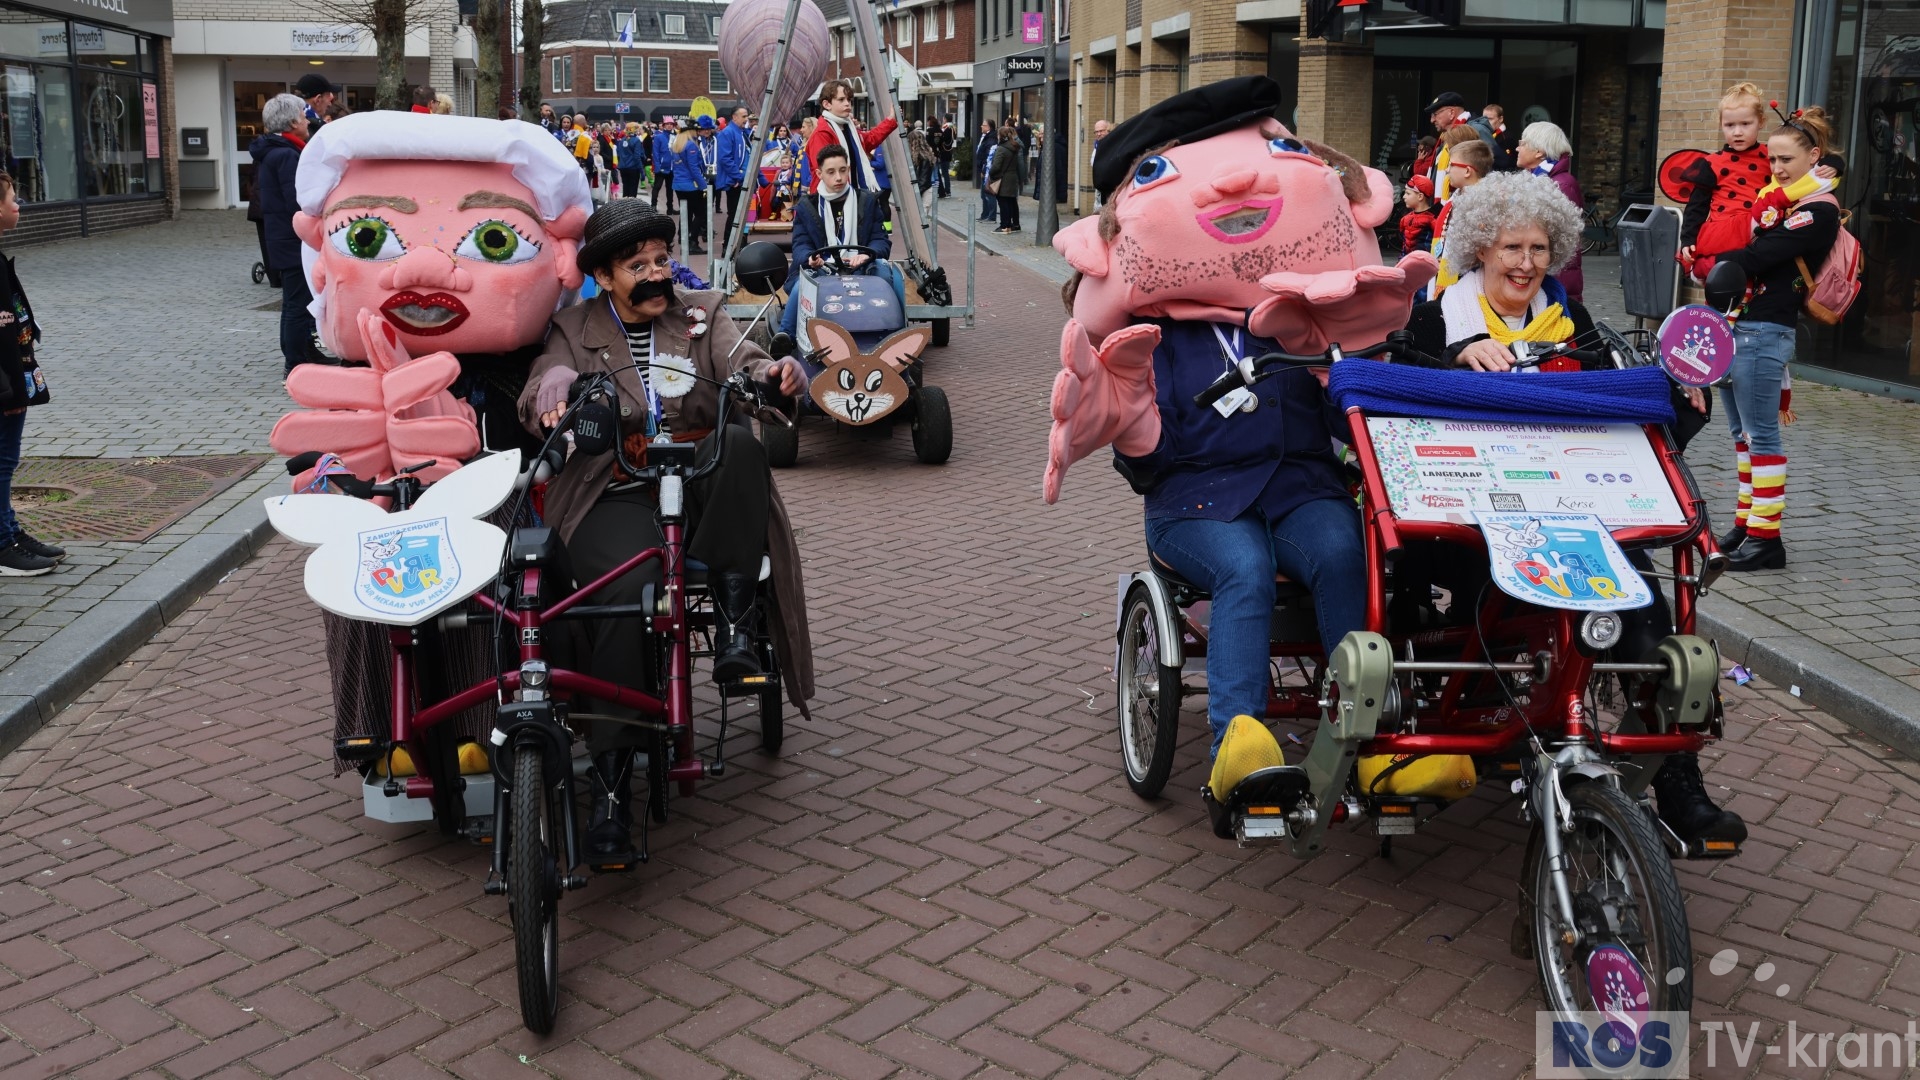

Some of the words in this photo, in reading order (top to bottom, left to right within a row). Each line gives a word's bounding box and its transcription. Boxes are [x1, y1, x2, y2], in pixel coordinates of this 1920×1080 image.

[292, 30, 329, 46] Fotografie
[332, 32, 356, 43] Sterre
[1008, 58, 1043, 71] shoeby
[578, 419, 602, 439] JBL
[1444, 423, 1526, 433] ANNENBORCH
[1529, 424, 1543, 433] IN
[1545, 424, 1608, 434] BEWEGING
[1422, 471, 1482, 479] LANGERAAP
[1556, 496, 1596, 511] Korse
[516, 710, 533, 718] AXA
